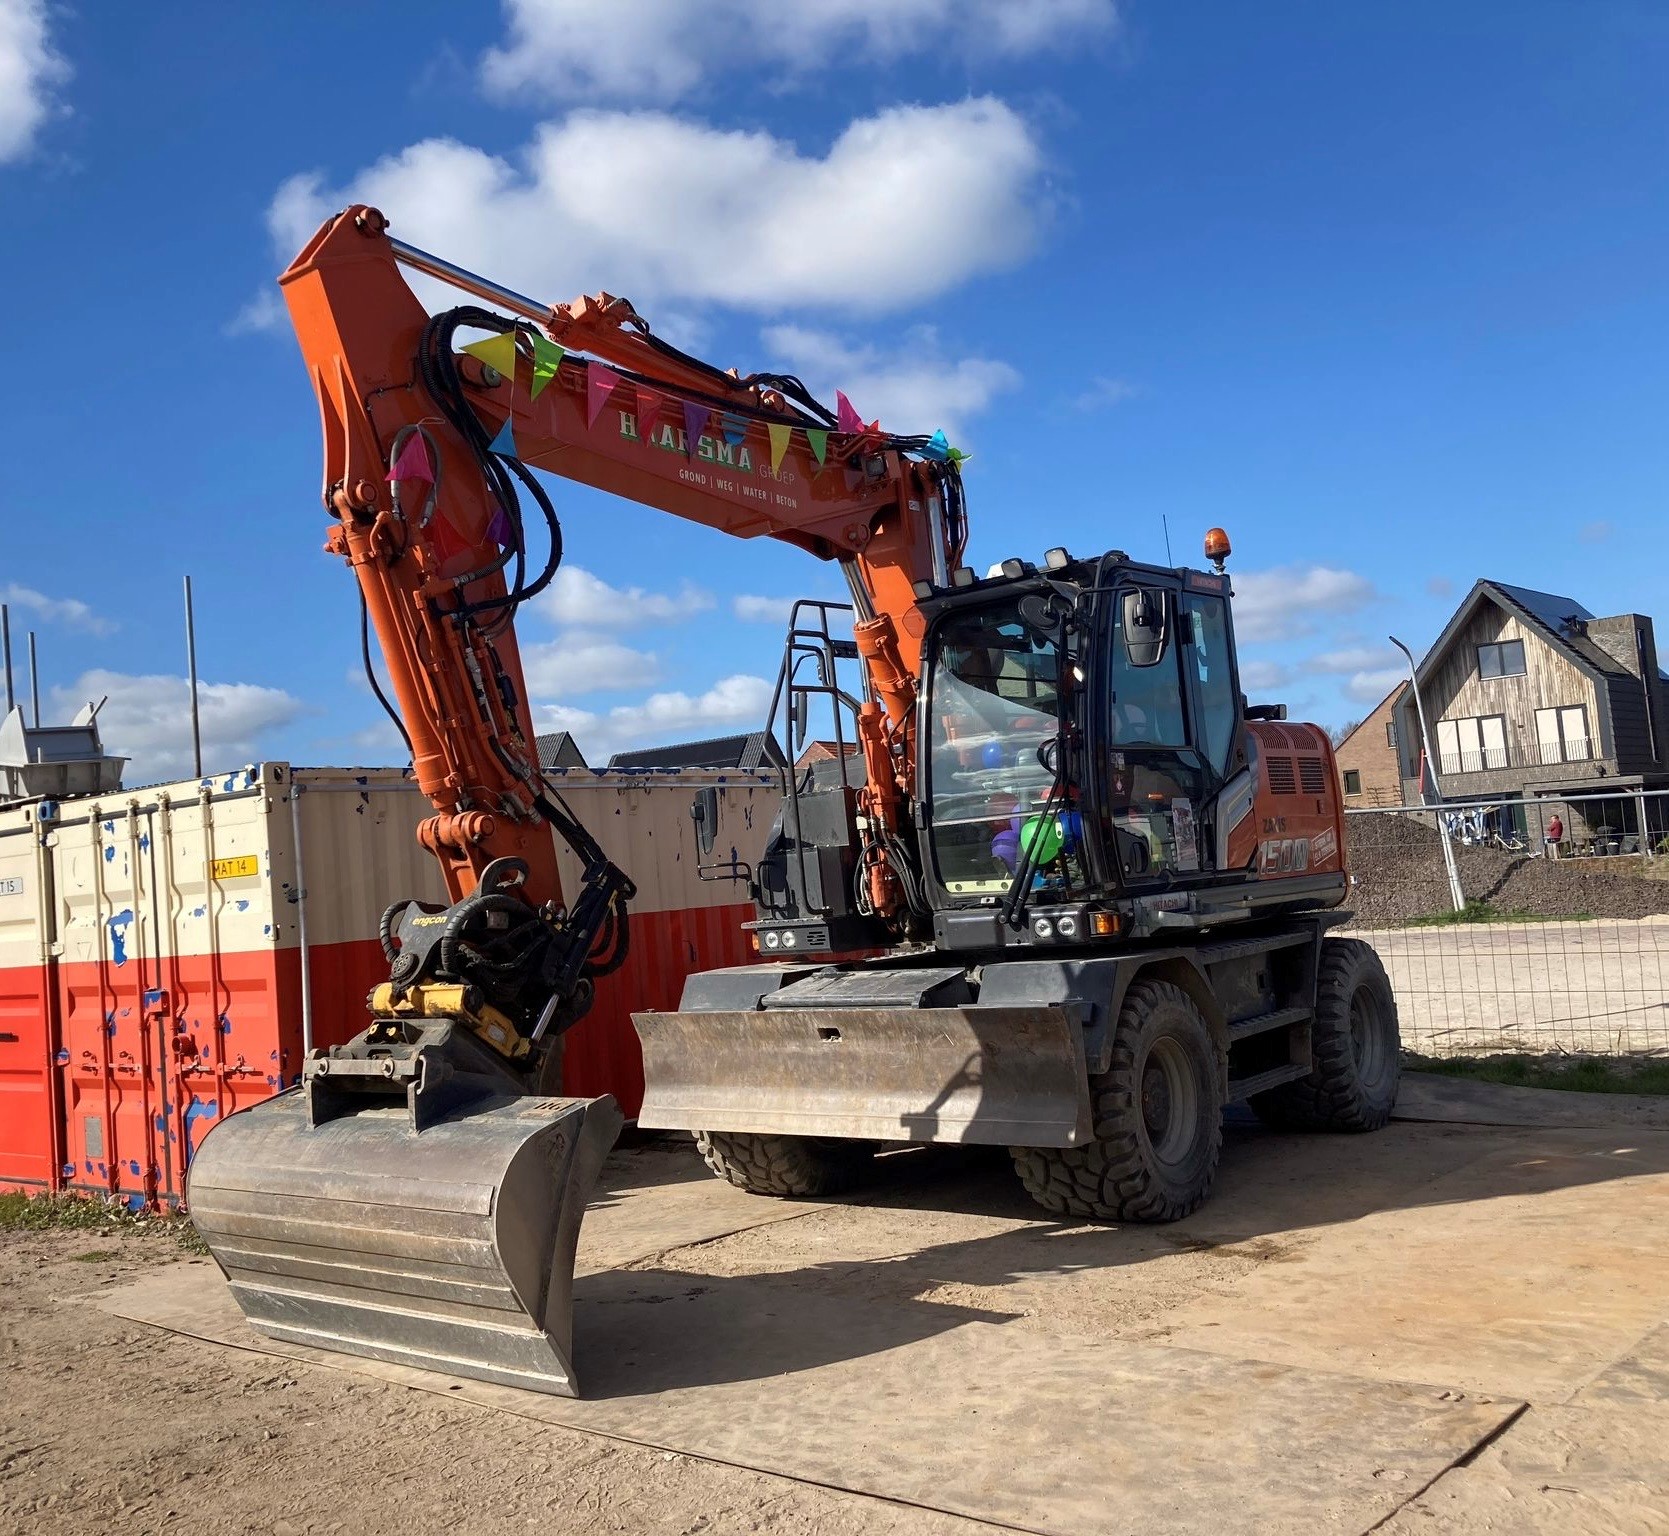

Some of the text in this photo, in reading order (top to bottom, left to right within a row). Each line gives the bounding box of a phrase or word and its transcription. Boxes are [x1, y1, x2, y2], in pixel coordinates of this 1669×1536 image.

[618, 410, 752, 471] HASMA
[679, 468, 798, 509] GROND WEG WATER BETON
[214, 859, 247, 876] MAT 14
[6, 880, 15, 893] 15
[412, 915, 448, 928] engcon
